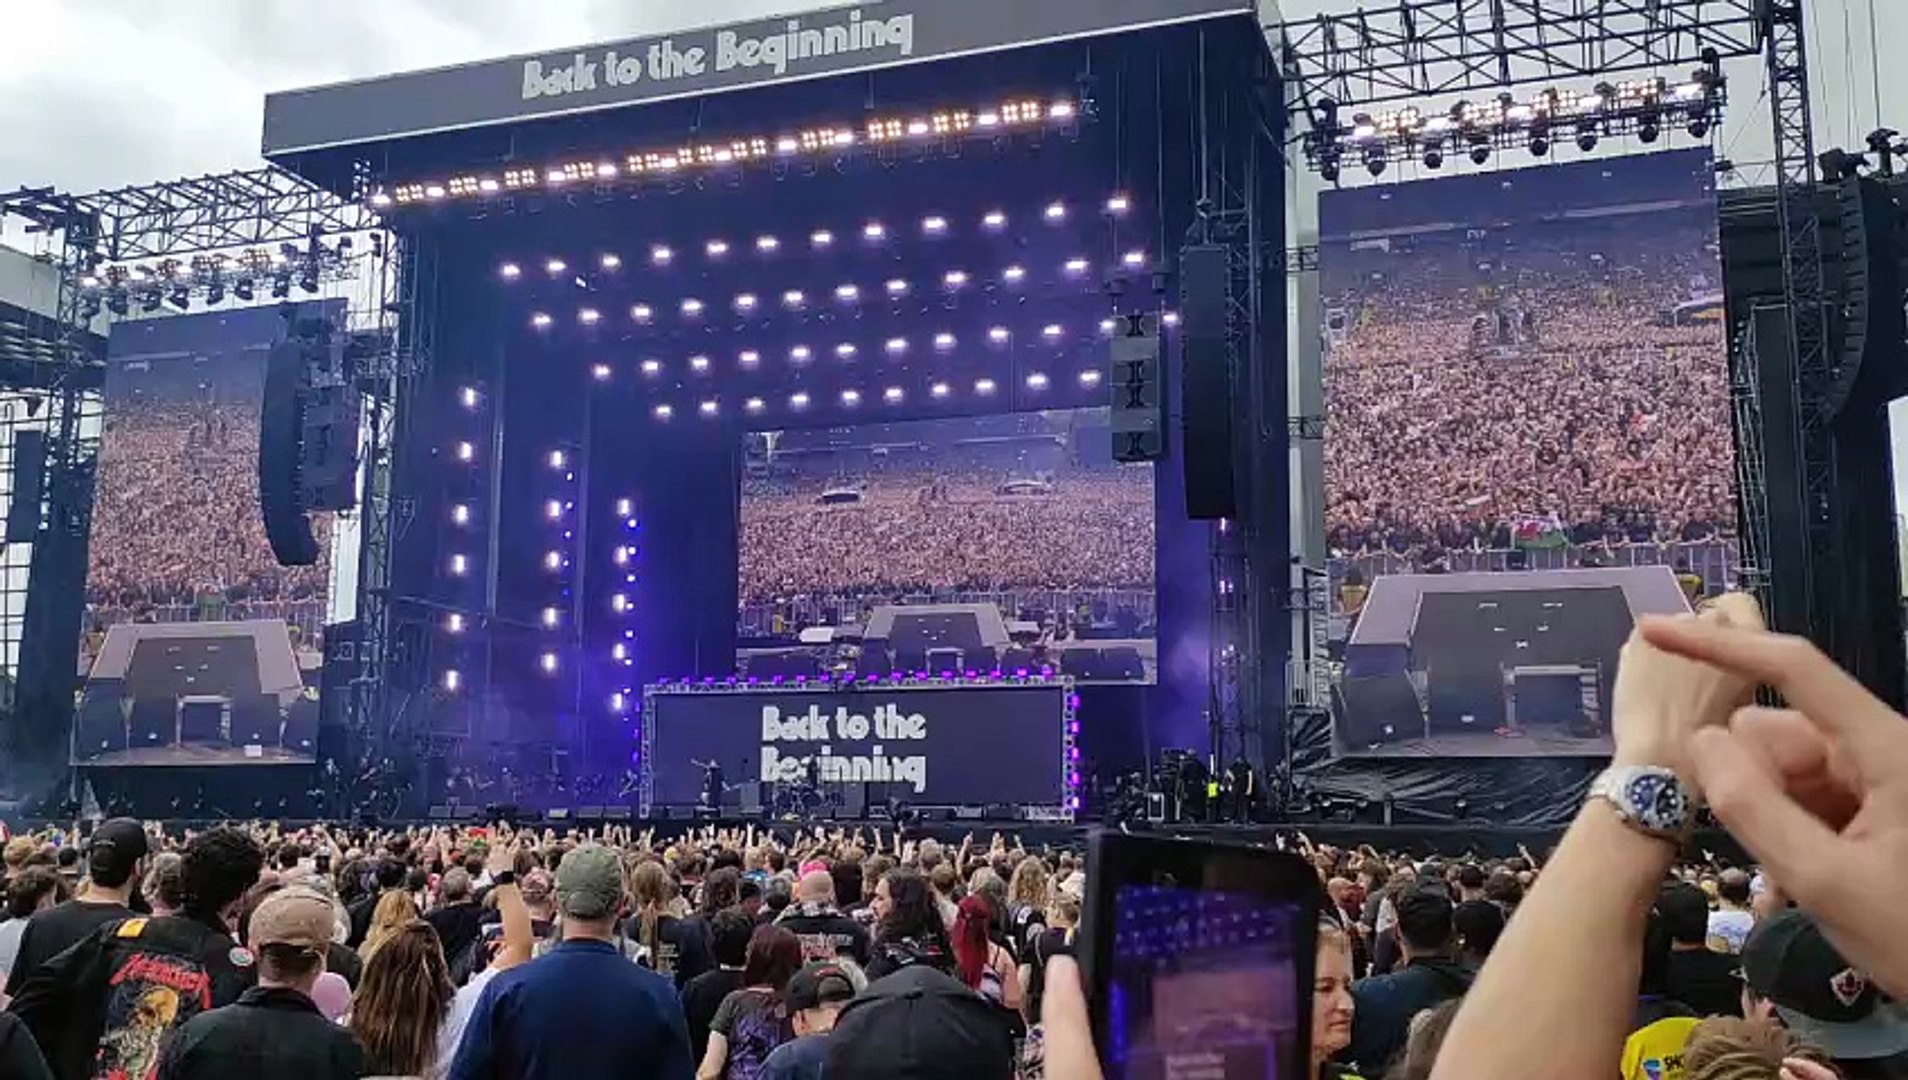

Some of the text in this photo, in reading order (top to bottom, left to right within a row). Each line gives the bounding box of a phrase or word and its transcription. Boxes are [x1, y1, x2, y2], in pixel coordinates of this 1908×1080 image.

[522, 9, 913, 99] Back to the Beginning
[762, 703, 926, 741] Back to the
